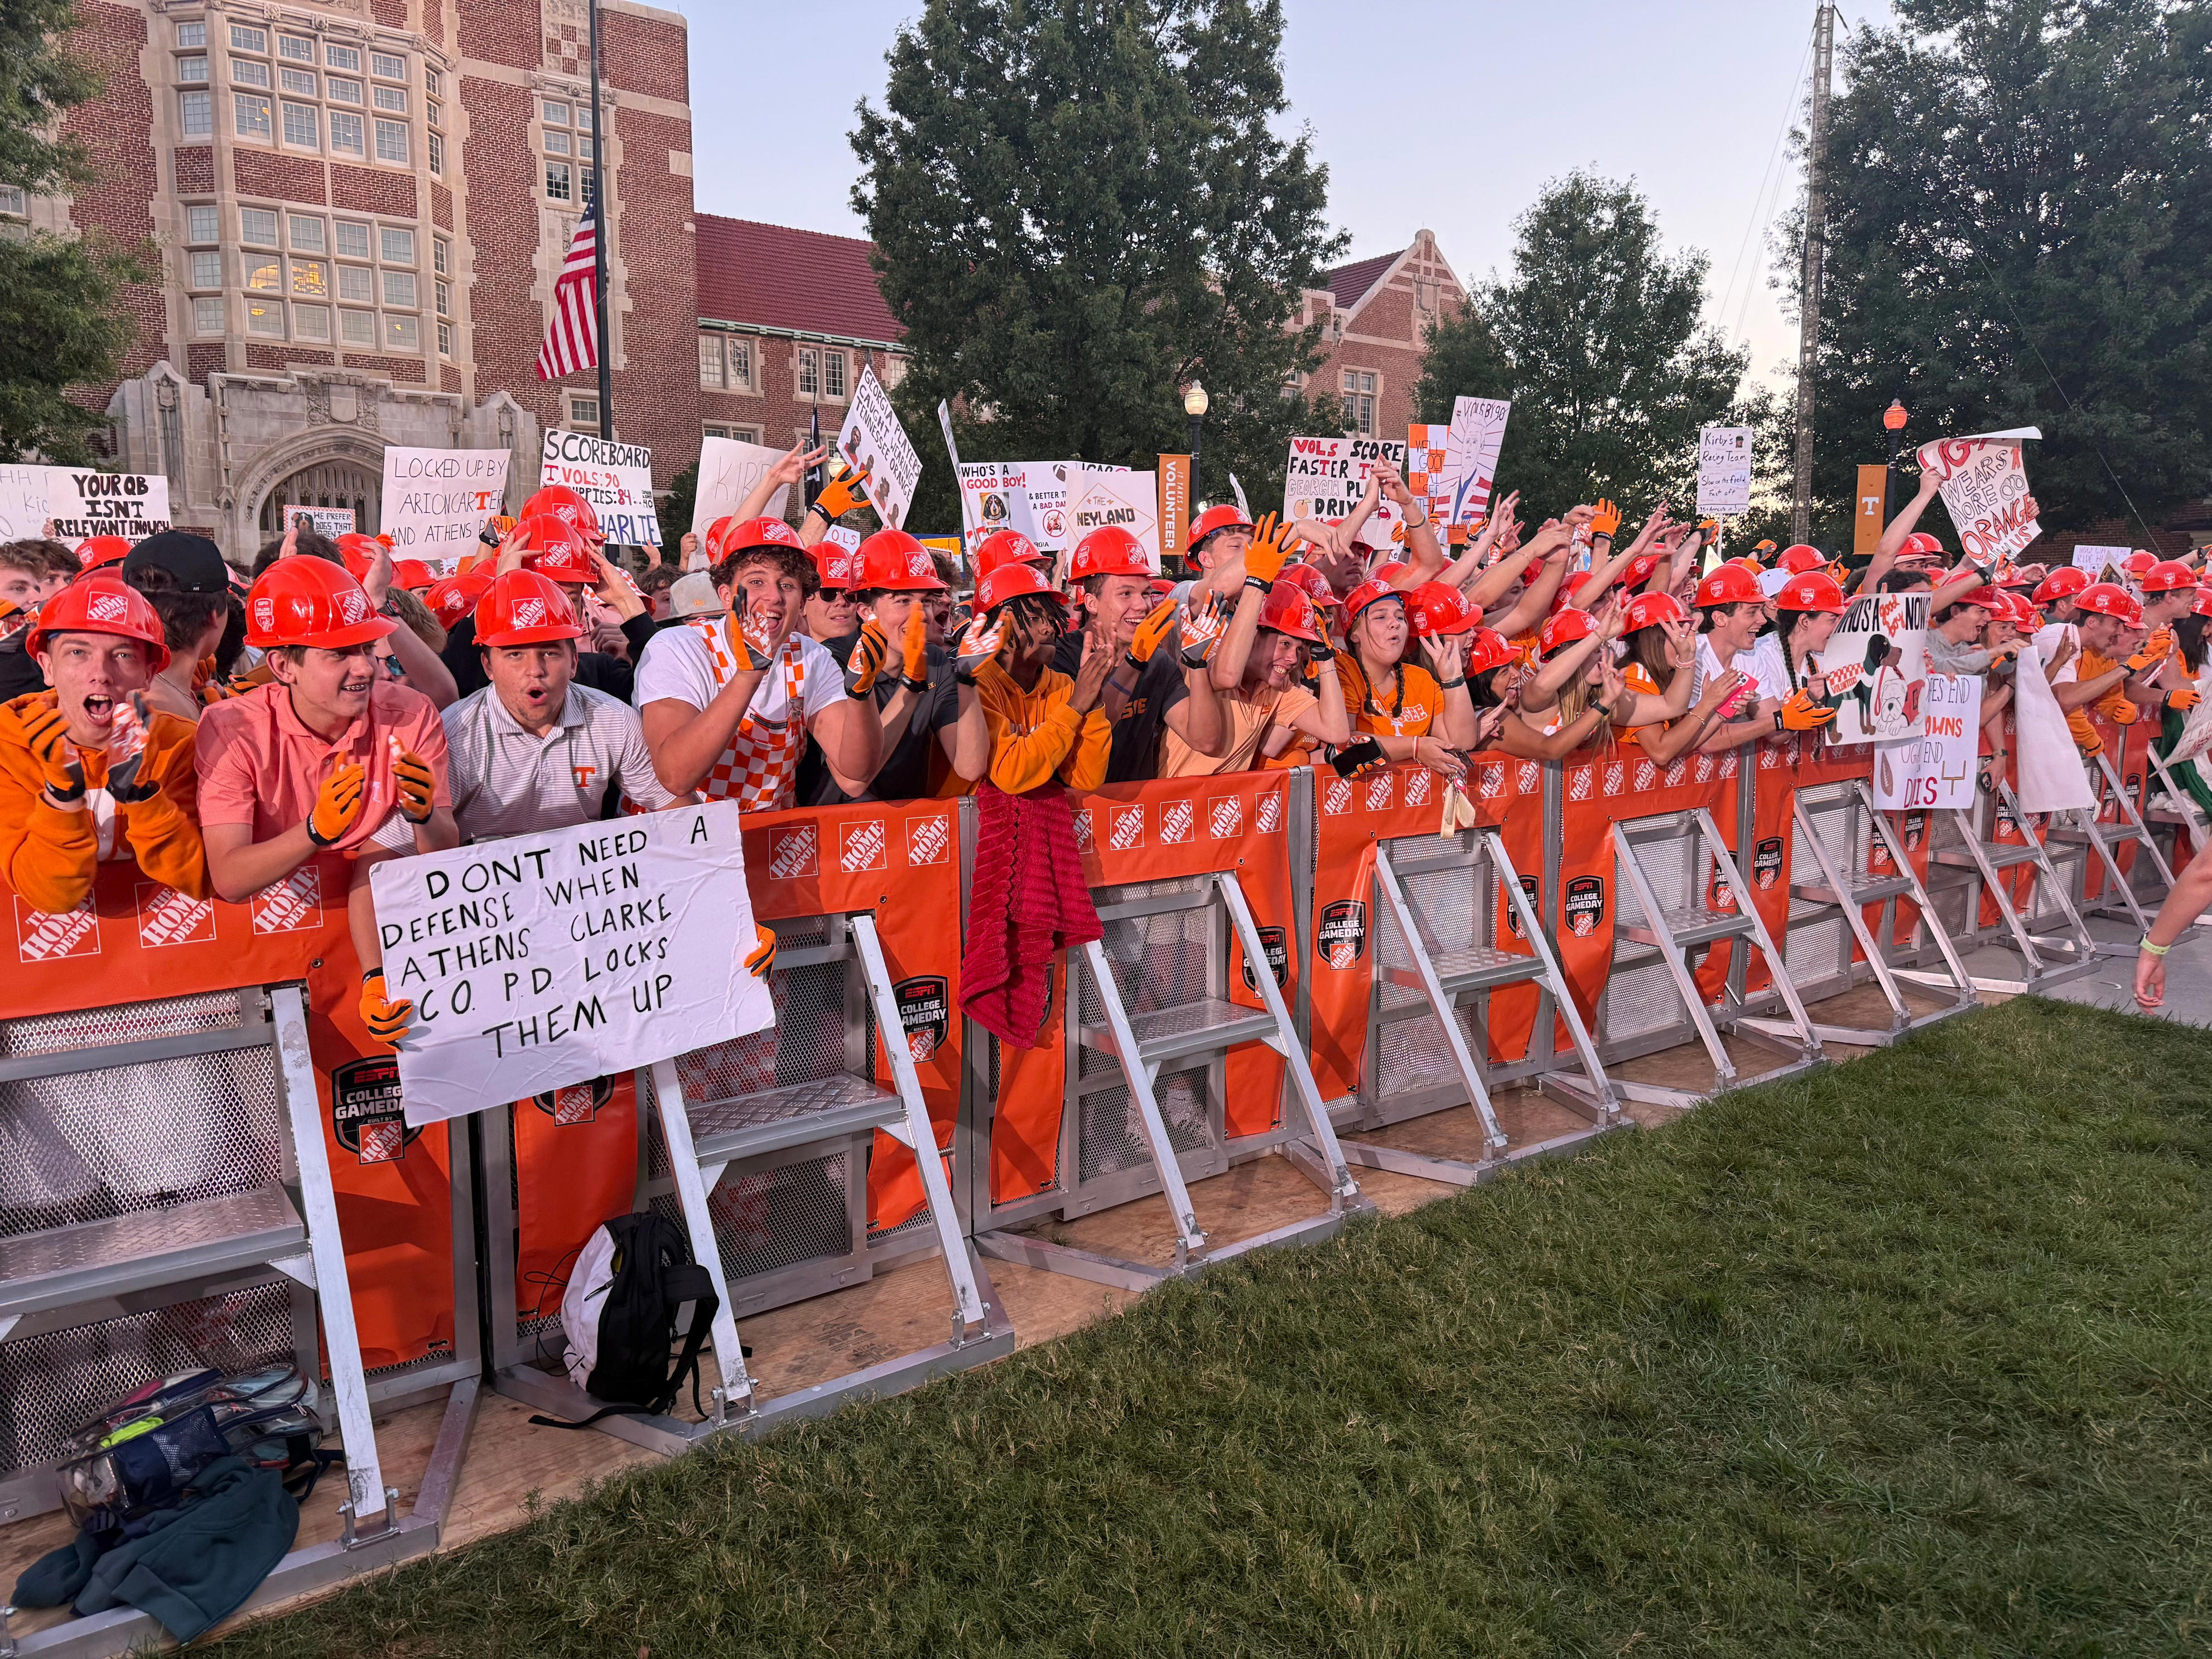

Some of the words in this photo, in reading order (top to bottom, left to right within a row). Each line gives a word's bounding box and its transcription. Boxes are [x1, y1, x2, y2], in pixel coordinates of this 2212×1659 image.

[860, 385, 889, 437] CAUGHT
[890, 437, 914, 485] WEARING
[865, 370, 893, 426] GEORGIA
[894, 423, 921, 477] PLAYERS
[544, 431, 650, 468] SCOREBOARD
[856, 396, 890, 461] TENNESSEE
[890, 459, 912, 503] ORANGE
[1294, 440, 1338, 456] VOLS
[1350, 440, 1404, 461] SCORE
[1705, 432, 1733, 446] Kirby's
[394, 457, 460, 478] LOCKED
[466, 460, 483, 477] UP
[487, 460, 506, 476] BY
[1289, 457, 1348, 478] FASTER
[1702, 451, 1724, 464] Racing
[1726, 451, 1746, 462] Team
[544, 465, 558, 481] T
[605, 473, 620, 488] 90
[961, 465, 995, 478] WHO'S
[1003, 465, 1009, 475] A
[966, 478, 997, 489] GOOD
[1003, 472, 1026, 489] BOY!
[1730, 475, 1746, 484] field
[1940, 450, 2007, 508] WEARS
[71, 474, 122, 498] YOUR
[124, 475, 148, 495] QB
[618, 489, 632, 505] 84
[1288, 479, 1339, 496] GEORGIA
[85, 500, 143, 518] ISN'T
[1093, 496, 1106, 505] THE
[1165, 461, 1176, 549] VOLUNTEER
[1862, 496, 1879, 515] T
[1950, 484, 1998, 530] MORE
[54, 518, 127, 537] RELEVANT
[129, 520, 170, 536] ENOUGH
[334, 522, 351, 531] THAT
[1077, 508, 1135, 526] NEYLAND
[1962, 492, 2036, 560] ORANGE
[391, 527, 415, 547] AND
[425, 523, 471, 542] ATHENS
[598, 514, 661, 545] HARLIE
[831, 529, 857, 545] OLS
[2009, 526, 2032, 549] US
[89, 596, 127, 619] HOME
[93, 596, 109, 605] THE
[517, 602, 529, 613] THE
[517, 599, 544, 627] HOME
[1872, 598, 1880, 631] A
[1948, 677, 1970, 703] END
[1924, 742, 1943, 764] END
[572, 767, 595, 788] T
[1370, 777, 1380, 791] THE
[1569, 765, 1592, 800] HOME
[1366, 772, 1392, 811] HOME
[1377, 786, 1392, 809] DEPOT
[1110, 805, 1144, 850] HOME
[1114, 811, 1128, 829] THE
[774, 833, 794, 854] THE
[909, 816, 948, 865] HOME
[911, 822, 929, 842] THE
[1123, 821, 1143, 848] DEPOT
[426, 848, 551, 899] DONT
[578, 830, 647, 866] NEED
[690, 816, 708, 845] A
[770, 826, 815, 878] HOME
[925, 832, 948, 864] DEPOT
[789, 846, 816, 877] DEPOT
[146, 887, 175, 912] THE
[254, 866, 319, 933] HOME
[258, 878, 286, 903] THE
[1570, 893, 1598, 903] COLLEGE
[281, 889, 320, 930] DEPOT
[381, 892, 514, 950] DEFENSE
[545, 862, 639, 907] WHEN
[1330, 907, 1353, 918] ESPN
[1566, 899, 1603, 911] GAMEDAY
[142, 890, 200, 946] HOM
[171, 899, 213, 943] DEPOT
[1325, 920, 1360, 929] COLLEGE
[52, 913, 97, 957] DEPOT
[401, 928, 531, 987] ATHENS
[570, 893, 672, 943] CLARKE
[1319, 927, 1365, 939] GAMEDAY
[584, 937, 669, 983] LOCKS
[1331, 944, 1354, 968] HOME
[905, 985, 935, 999] ESPN
[482, 994, 608, 1058] THEM
[633, 975, 673, 1014] UP
[900, 999, 941, 1015] COLLEGE
[902, 1008, 947, 1026] AMEDAY
[346, 1085, 403, 1105] COLLEG
[556, 1086, 593, 1124] HOME
[558, 1090, 573, 1106] THE
[570, 1097, 594, 1121] DEPOT
[360, 1121, 402, 1162] HOME
[364, 1127, 381, 1144] THE
[378, 1135, 403, 1160] DEPOT
